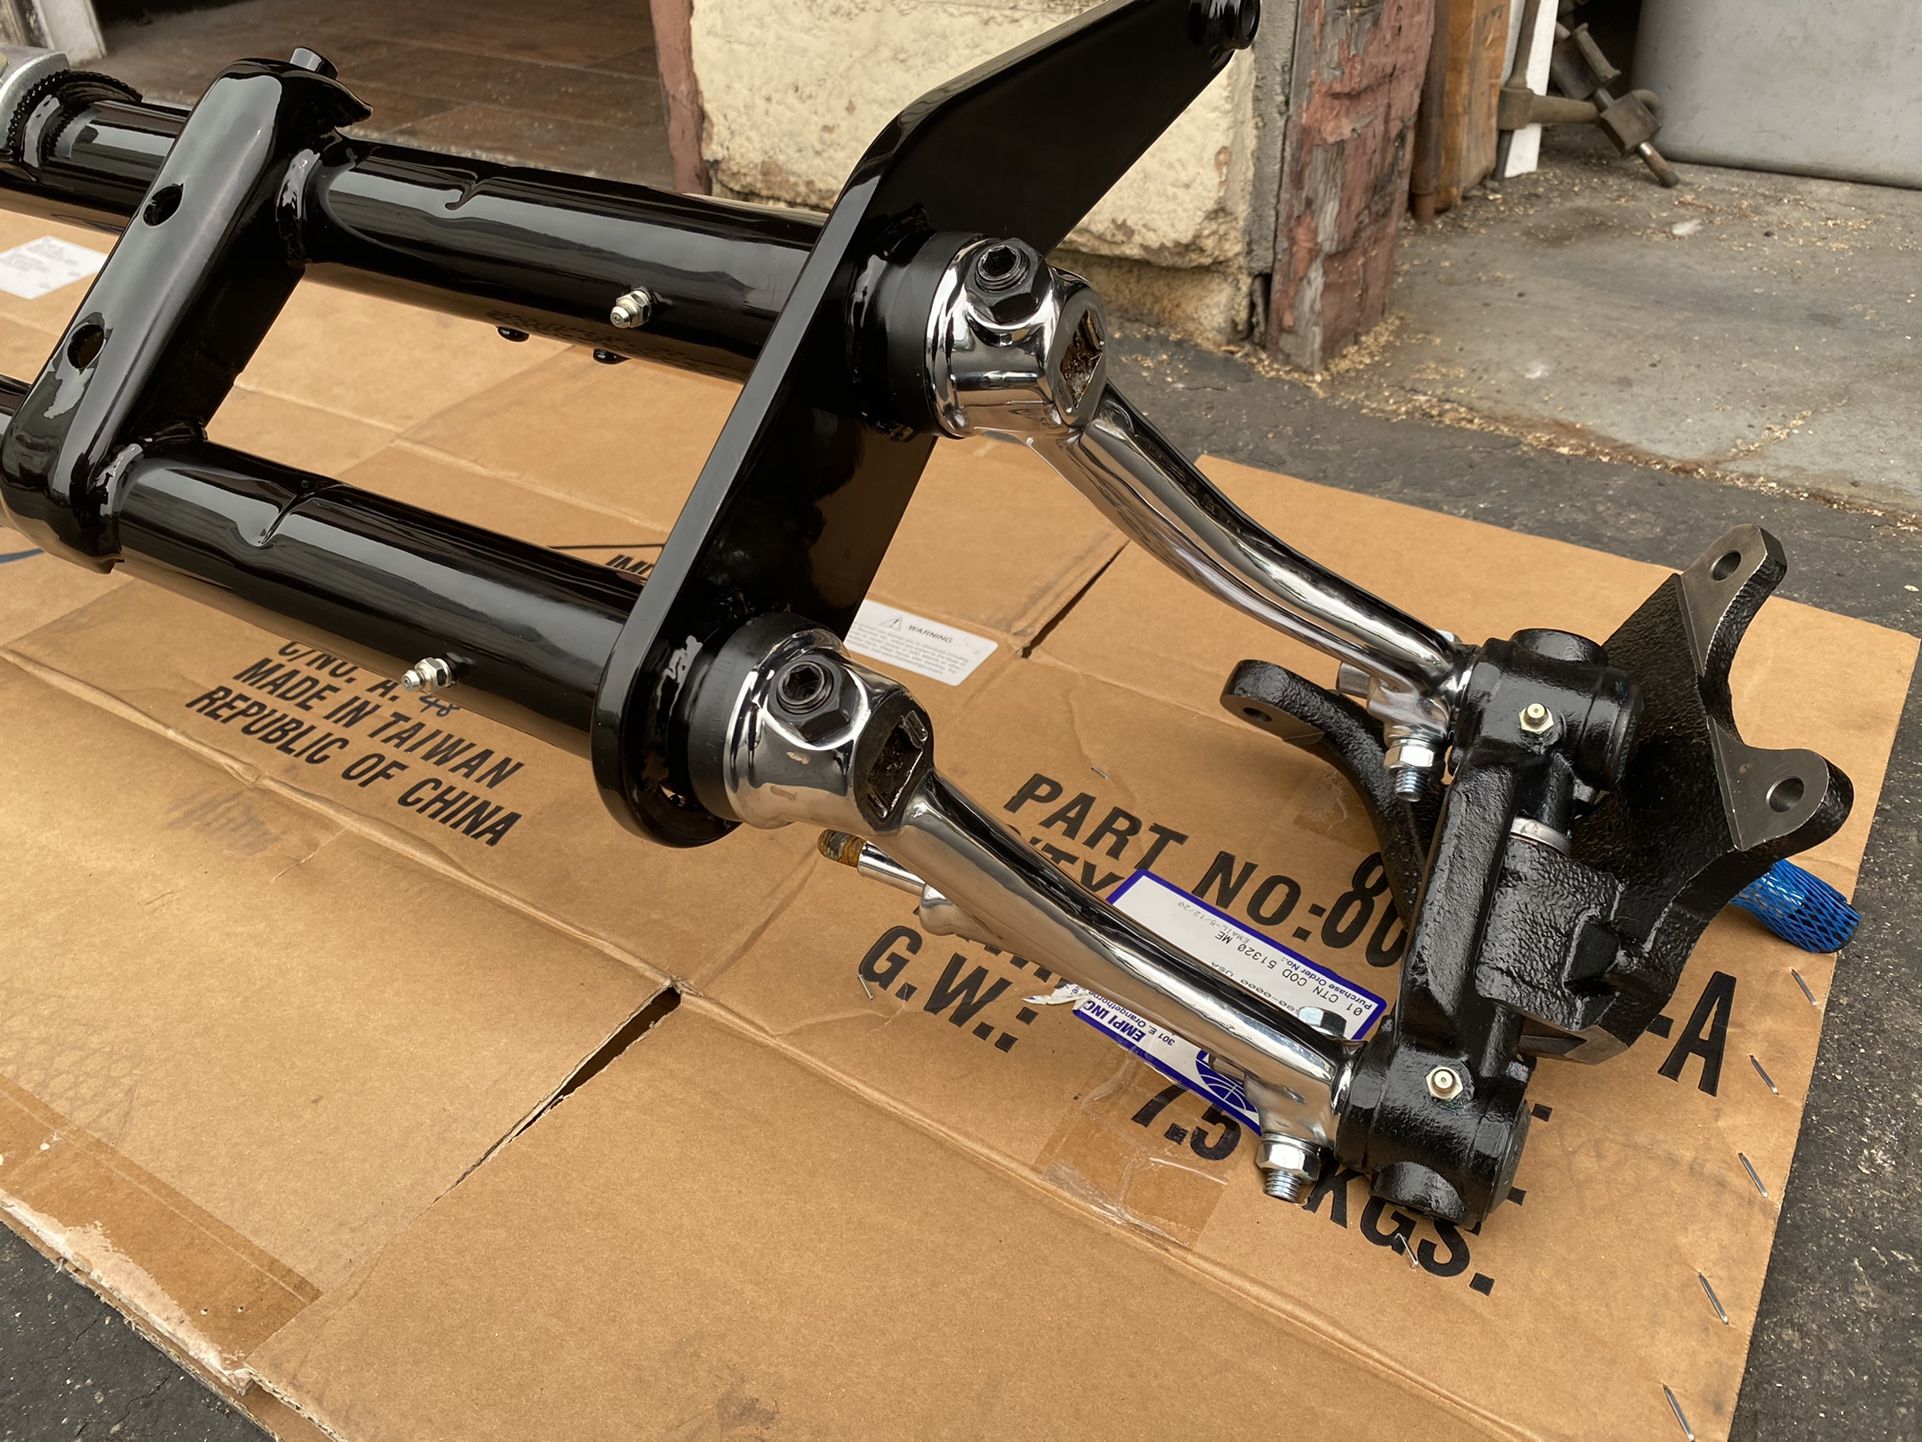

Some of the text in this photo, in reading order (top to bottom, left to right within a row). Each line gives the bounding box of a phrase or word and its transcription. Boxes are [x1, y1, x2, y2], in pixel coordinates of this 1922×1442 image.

[908, 624, 952, 643] WARNING
[232, 657, 525, 789] MADE IN TAIWAN
[185, 685, 523, 847] REPUBLIC OF CHINA
[1003, 773, 1189, 870] PART
[1215, 930, 1363, 1016] 01 CTN COD 51320 ME
[1300, 968, 1327, 986] Order
[1328, 983, 1372, 1010] Purchase
[1083, 1000, 1146, 1042] EMPI INC
[1158, 1034, 1175, 1046] 301
